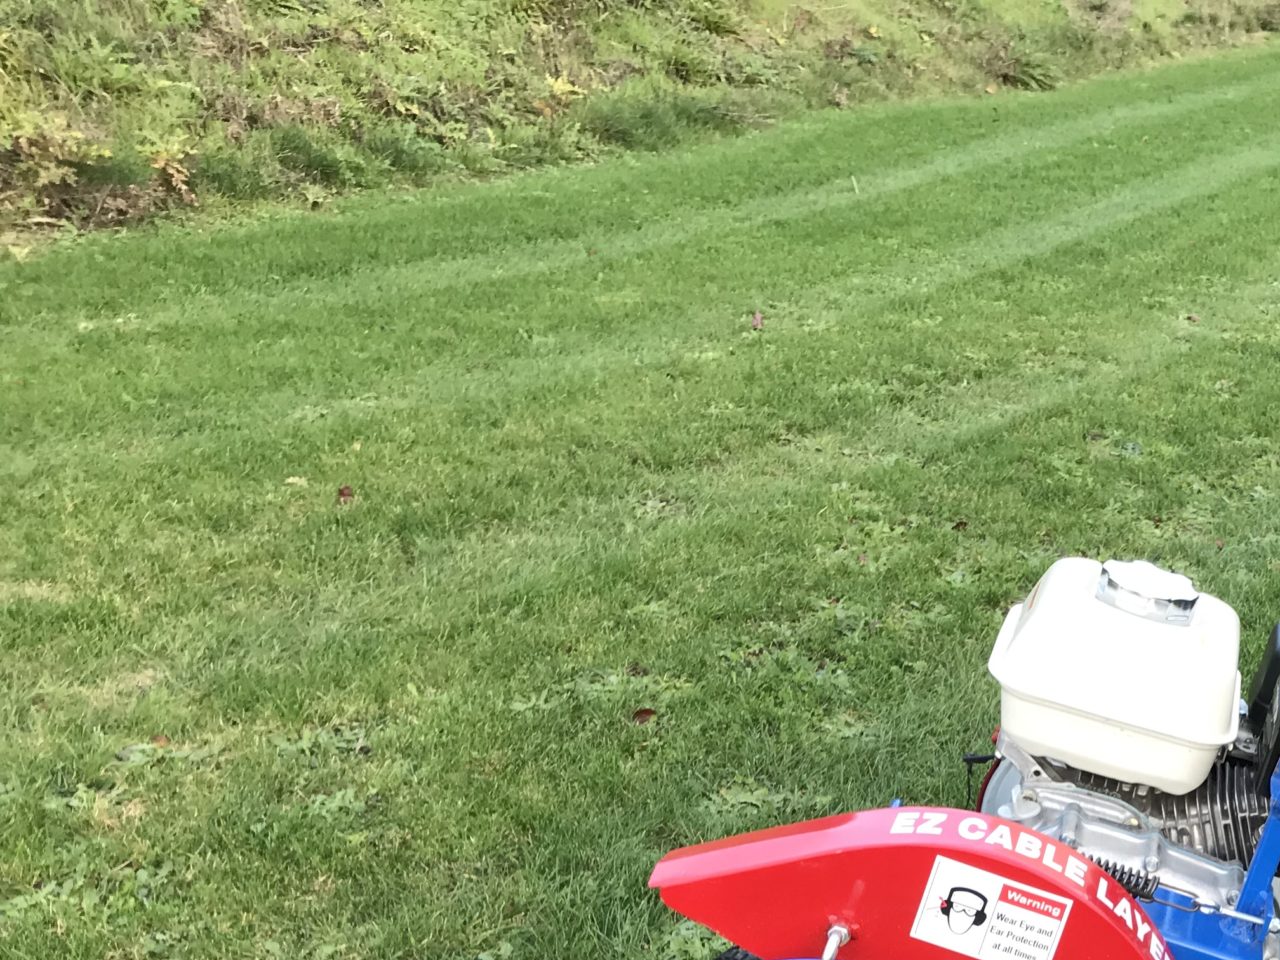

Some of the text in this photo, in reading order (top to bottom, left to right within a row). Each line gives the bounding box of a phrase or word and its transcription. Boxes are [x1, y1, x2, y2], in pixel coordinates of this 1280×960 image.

[890, 812, 947, 834] EZ
[958, 817, 1088, 887] CABLE
[1007, 890, 1061, 917] Warning
[989, 925, 1049, 952] Ear Protection
[996, 912, 1053, 938] Wear Eye and
[992, 942, 1001, 950] at
[1002, 945, 1013, 954] all
